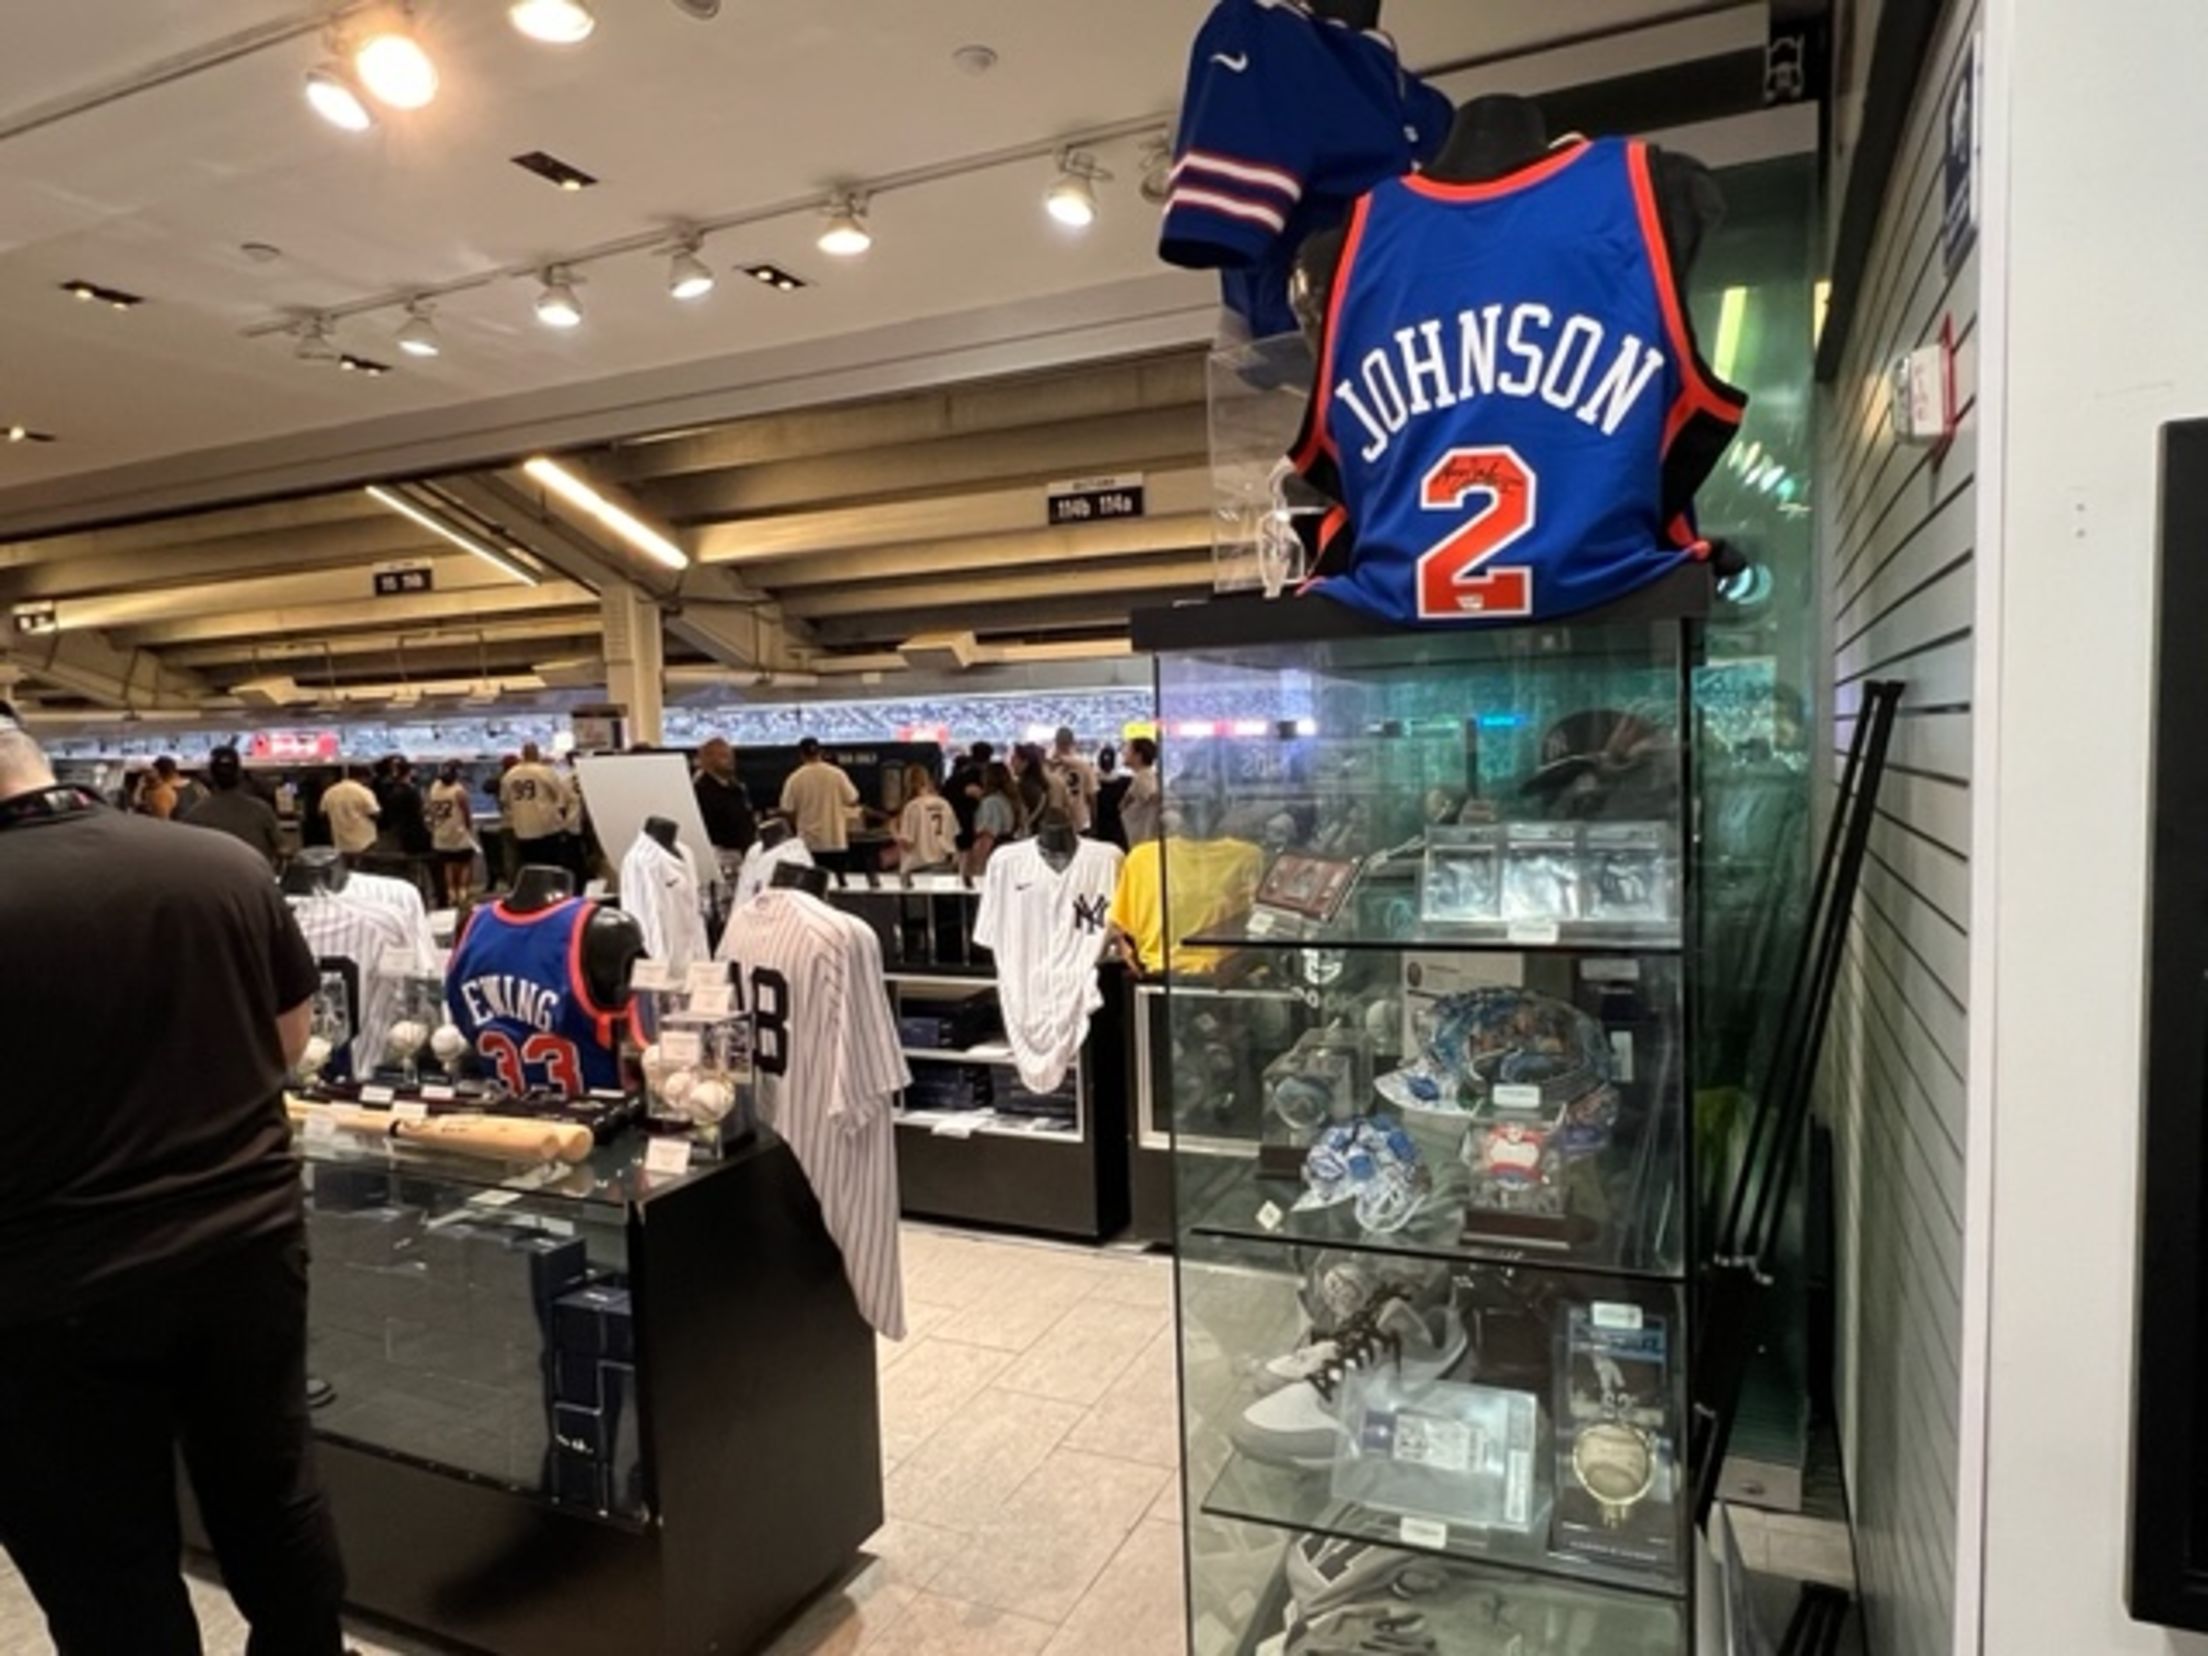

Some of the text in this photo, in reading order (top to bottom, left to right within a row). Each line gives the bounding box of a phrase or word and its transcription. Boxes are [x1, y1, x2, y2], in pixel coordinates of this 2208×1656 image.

[1335, 303, 1664, 463] JOHNSON
[1417, 445, 1536, 619] 2
[930, 813, 943, 837] 7
[1073, 893, 1112, 934] NY
[461, 973, 559, 1033] EWING
[477, 1030, 584, 1099] 33
